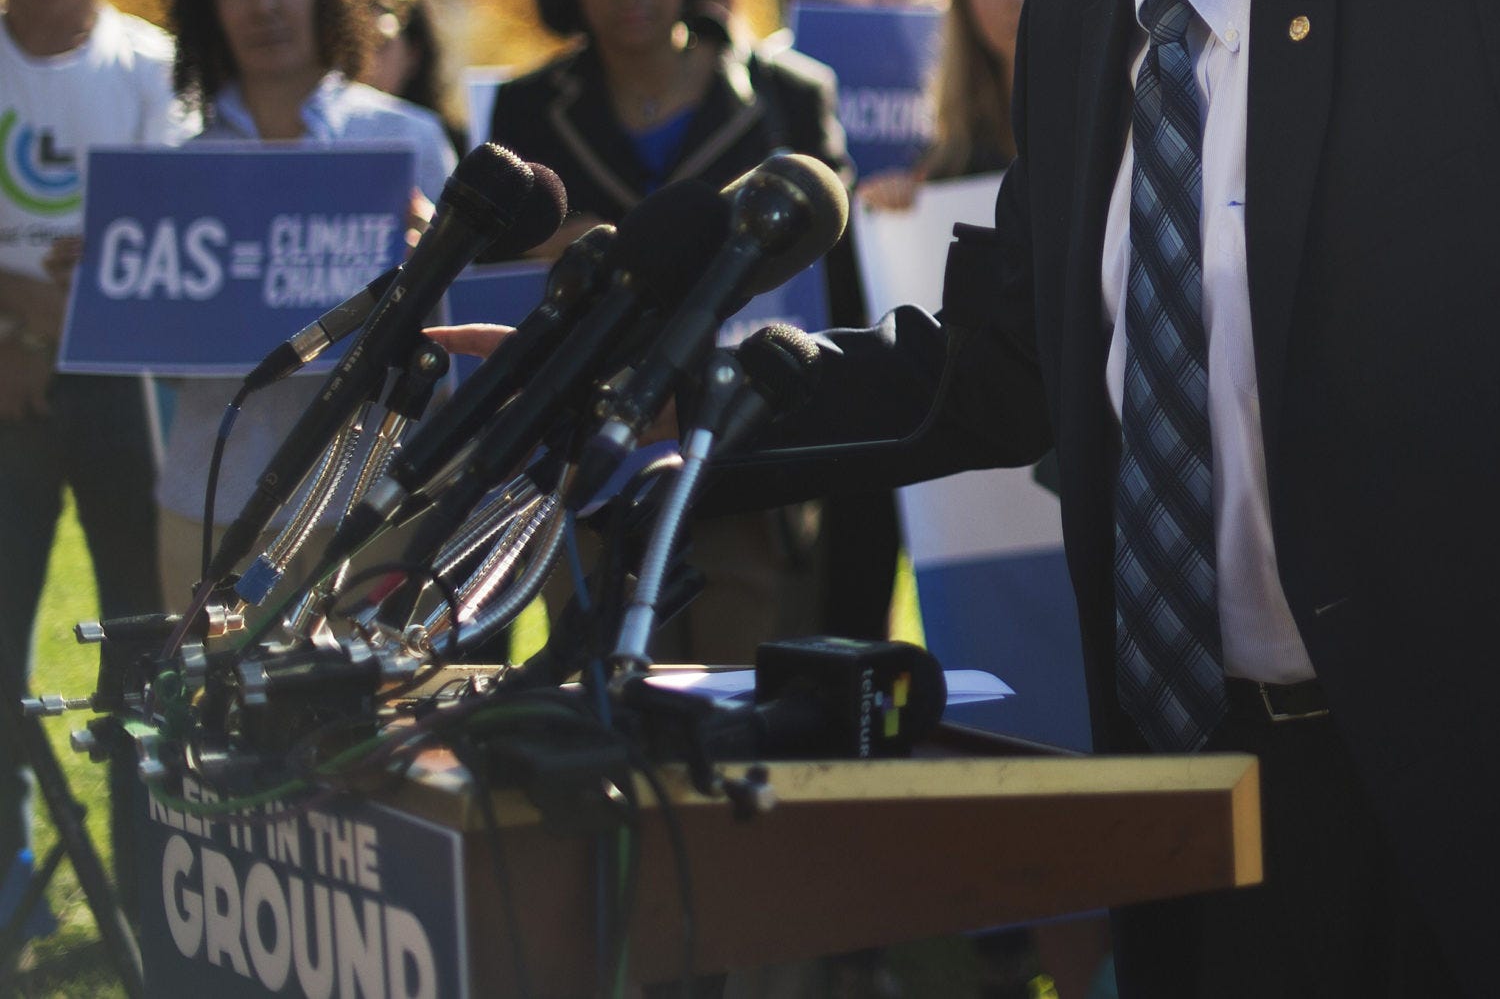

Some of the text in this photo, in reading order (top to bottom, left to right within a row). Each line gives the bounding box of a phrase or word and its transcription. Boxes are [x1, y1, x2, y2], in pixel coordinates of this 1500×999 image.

[100, 216, 227, 300] GAS
[271, 214, 397, 265] CLIMATE
[307, 809, 380, 891] THE
[162, 834, 438, 999] GROUND
